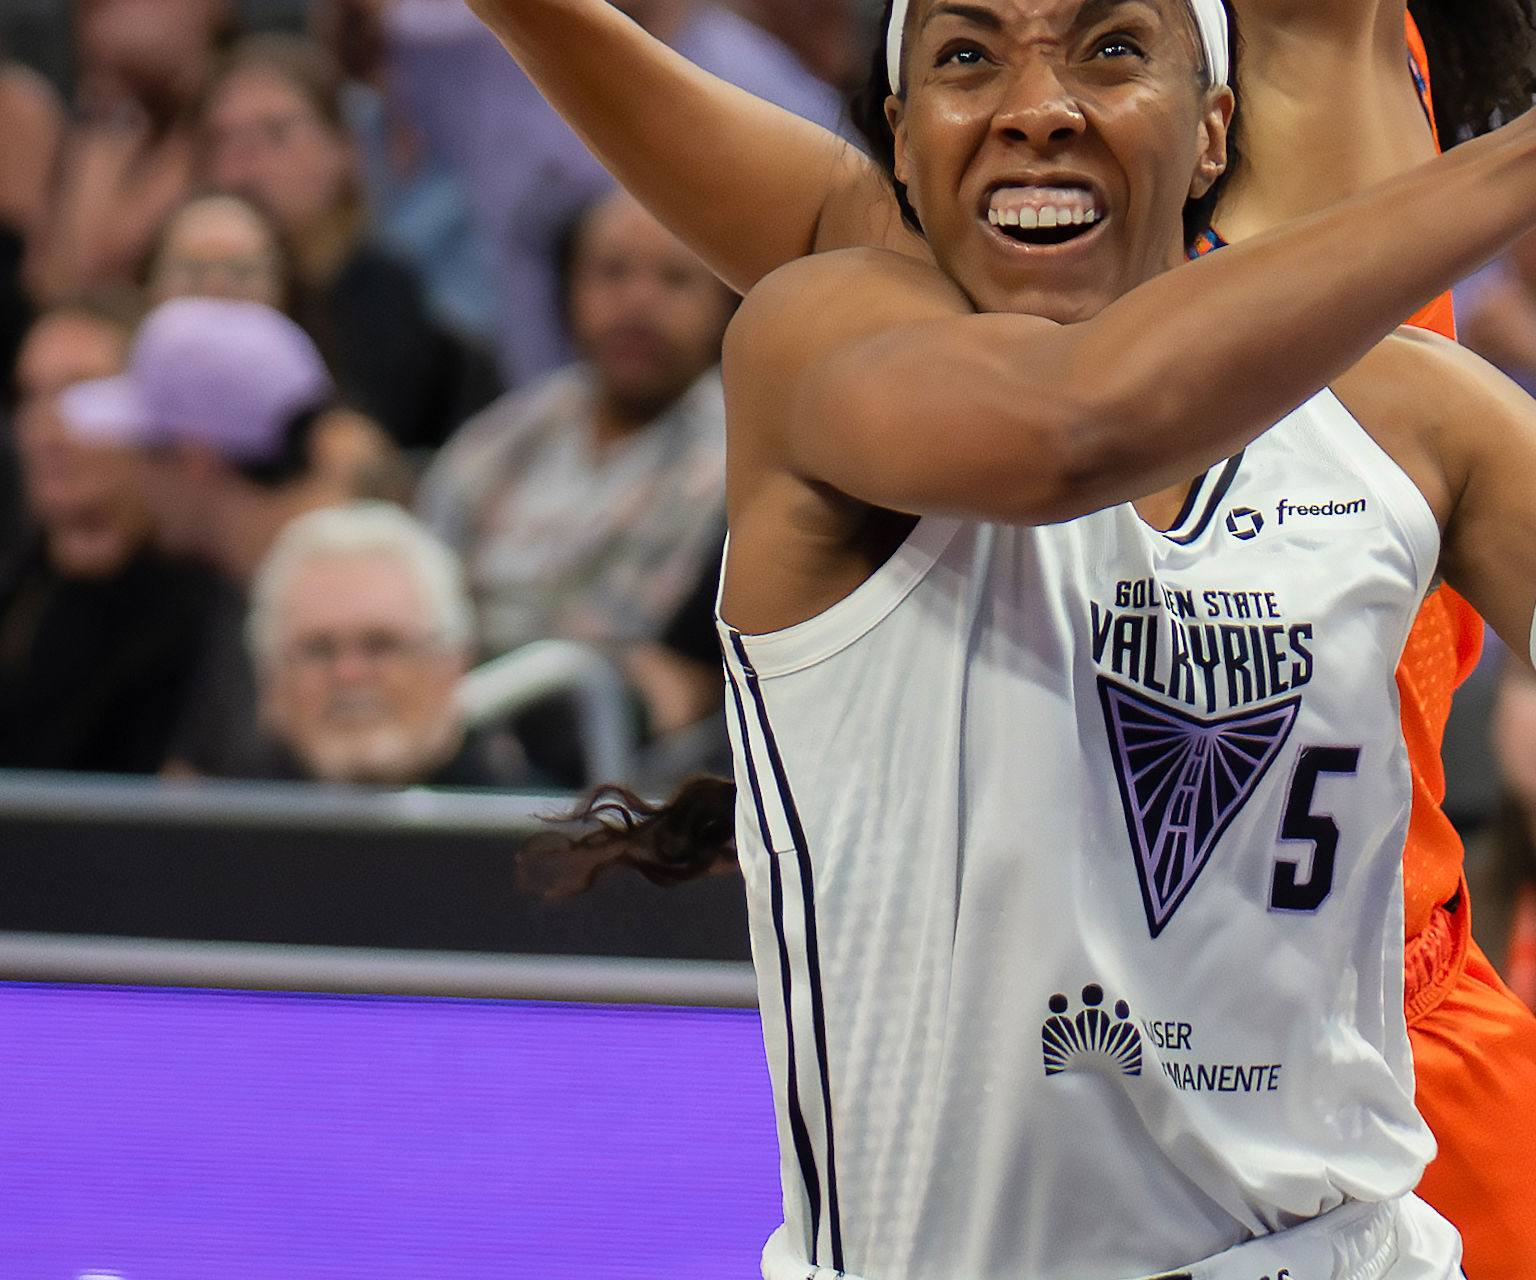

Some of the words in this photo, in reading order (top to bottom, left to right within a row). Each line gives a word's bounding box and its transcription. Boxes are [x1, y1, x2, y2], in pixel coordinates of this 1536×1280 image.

[1276, 498, 1366, 525] freedom
[1115, 577, 1196, 620] GOLEN
[1203, 590, 1281, 619] STATE
[1090, 599, 1313, 714] VALKYRIES
[1268, 746, 1362, 912] 5
[1162, 1062, 1283, 1093] MANENTE
